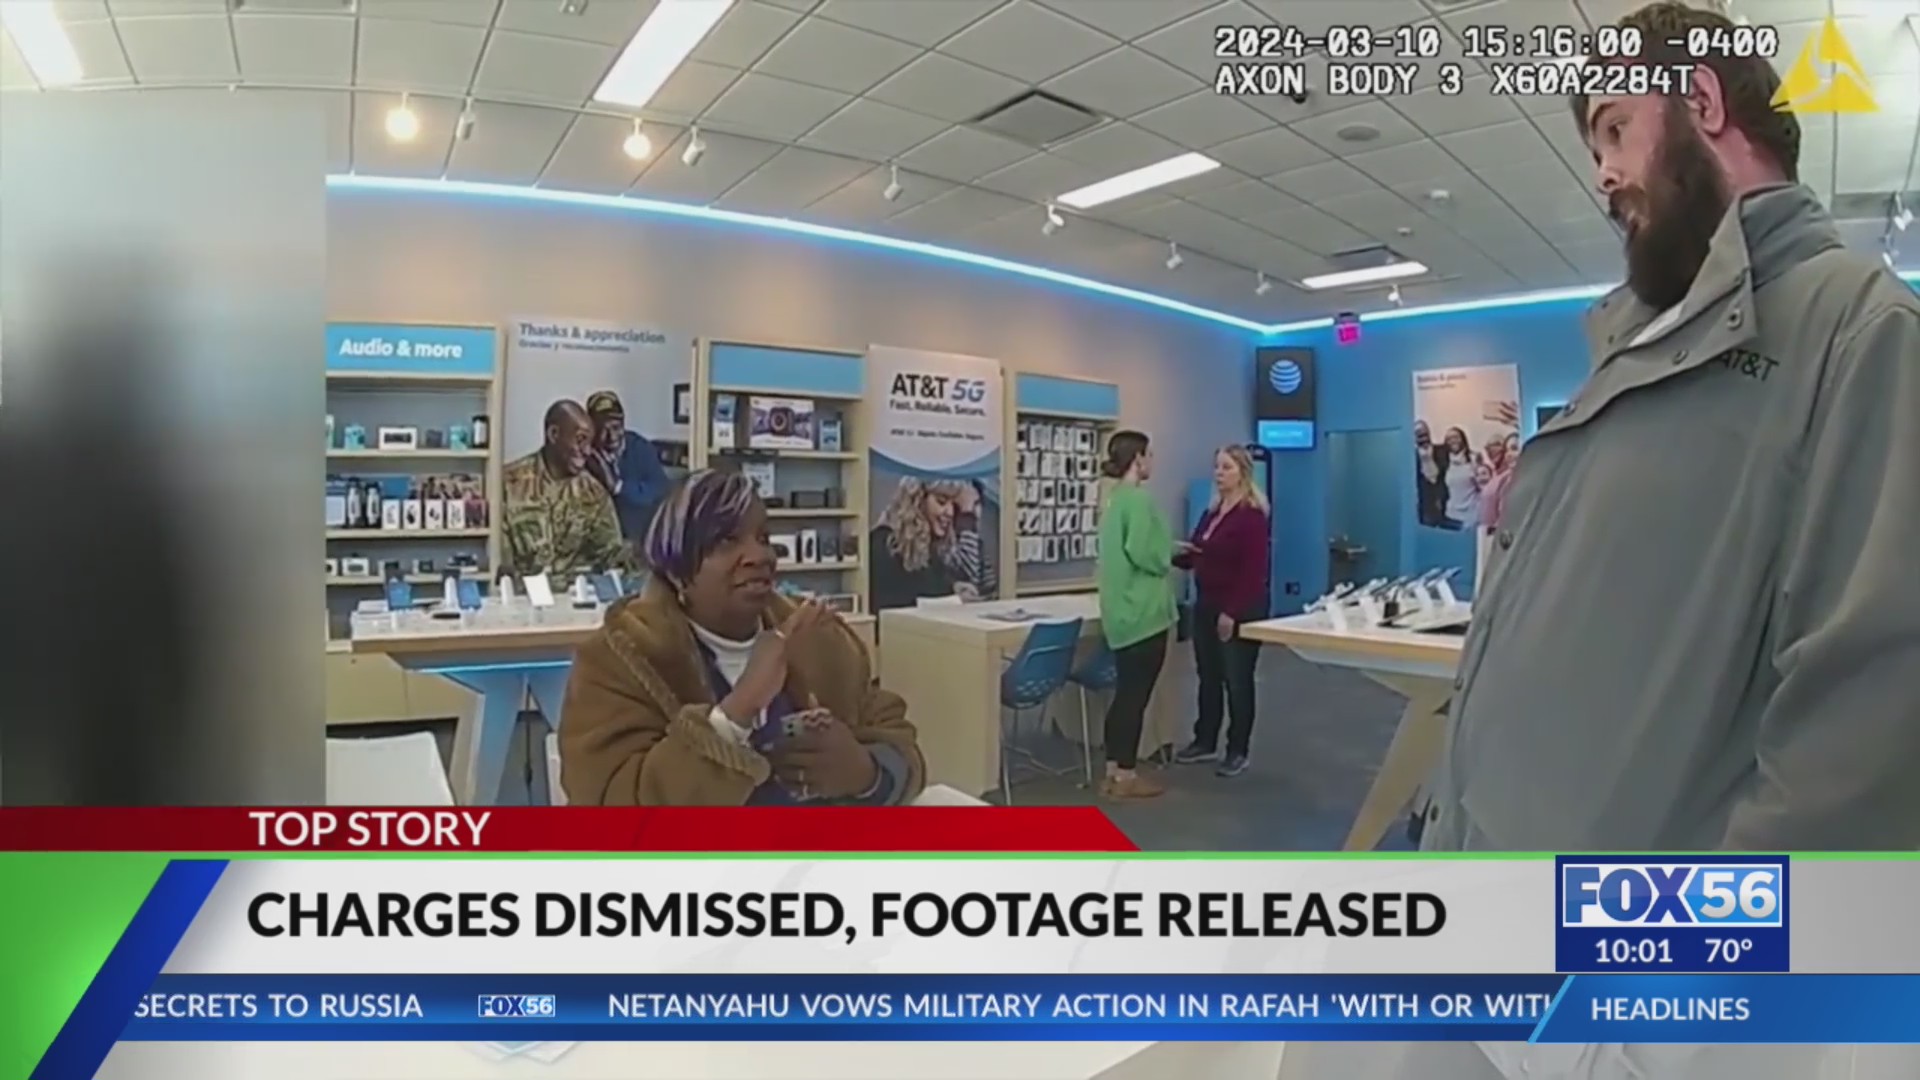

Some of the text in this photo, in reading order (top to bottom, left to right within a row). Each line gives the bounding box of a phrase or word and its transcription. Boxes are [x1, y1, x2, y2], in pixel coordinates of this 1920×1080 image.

[519, 322, 666, 344] Thanks & appreciation
[339, 337, 463, 359] Audio & more
[891, 372, 985, 403] AT&T 5G
